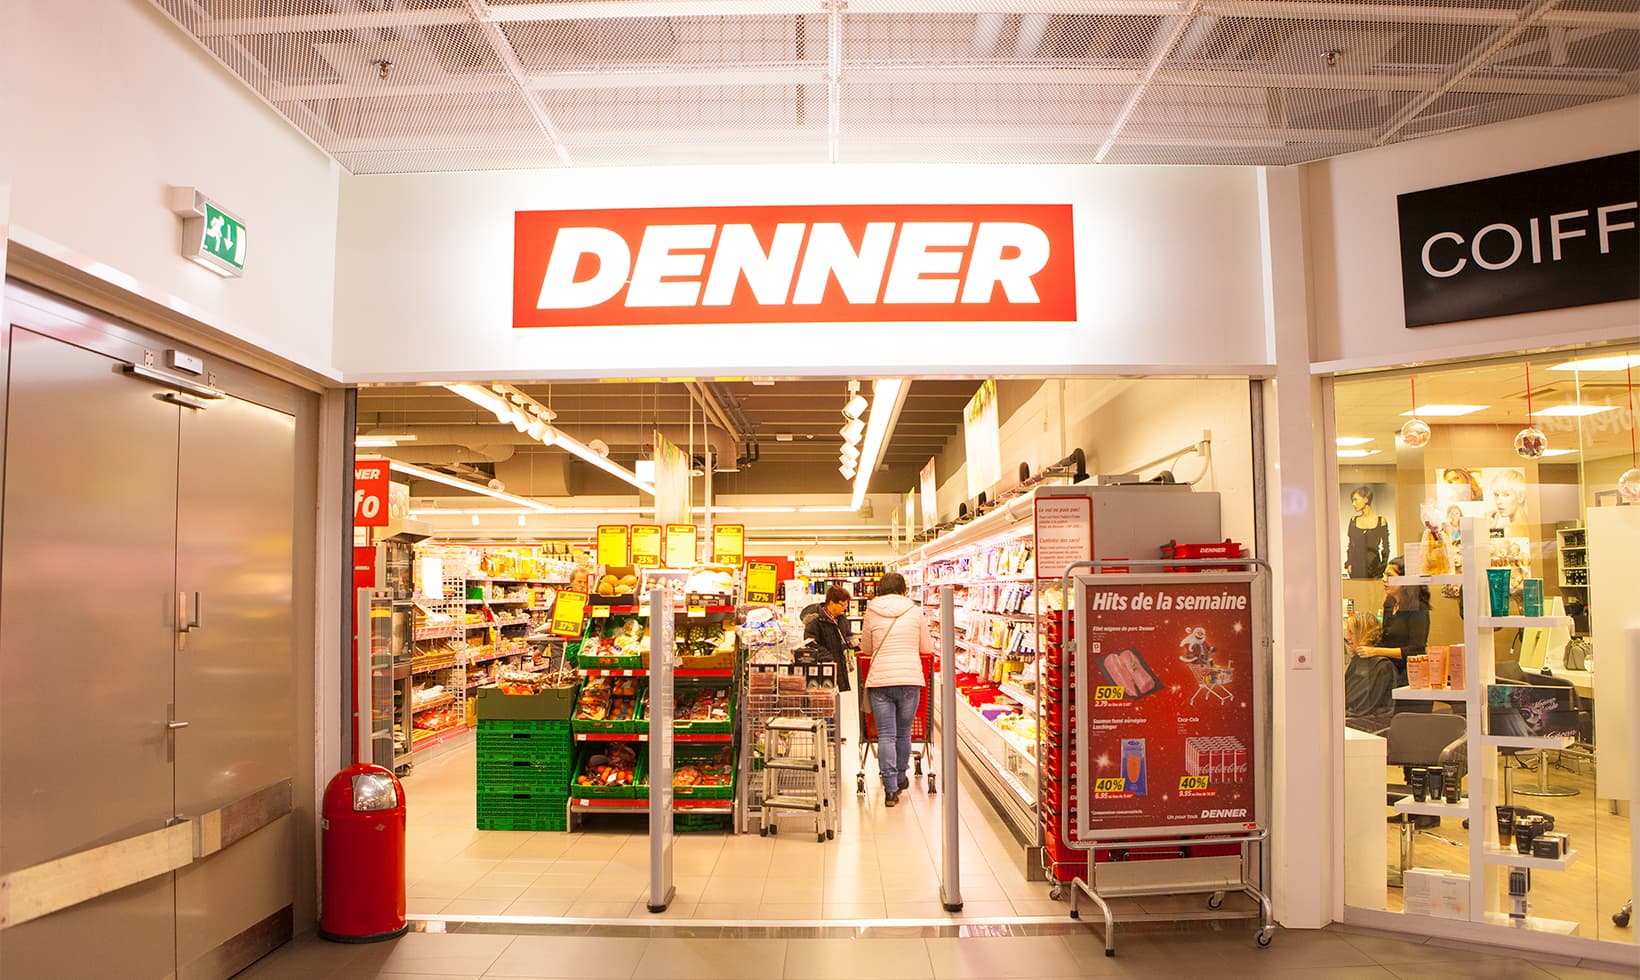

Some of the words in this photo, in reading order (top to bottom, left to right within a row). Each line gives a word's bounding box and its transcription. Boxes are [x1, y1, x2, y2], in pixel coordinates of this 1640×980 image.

[1421, 201, 1638, 278] COIFF
[536, 222, 1051, 309] DENNER
[1092, 592, 1129, 611] Hits
[1131, 592, 1153, 611] de
[1156, 592, 1172, 611] la
[1175, 592, 1247, 610] semaine
[1097, 687, 1122, 699] 50%
[1097, 779, 1123, 790] 40%
[1181, 777, 1206, 789] 40%
[1200, 808, 1247, 819] DENNER
